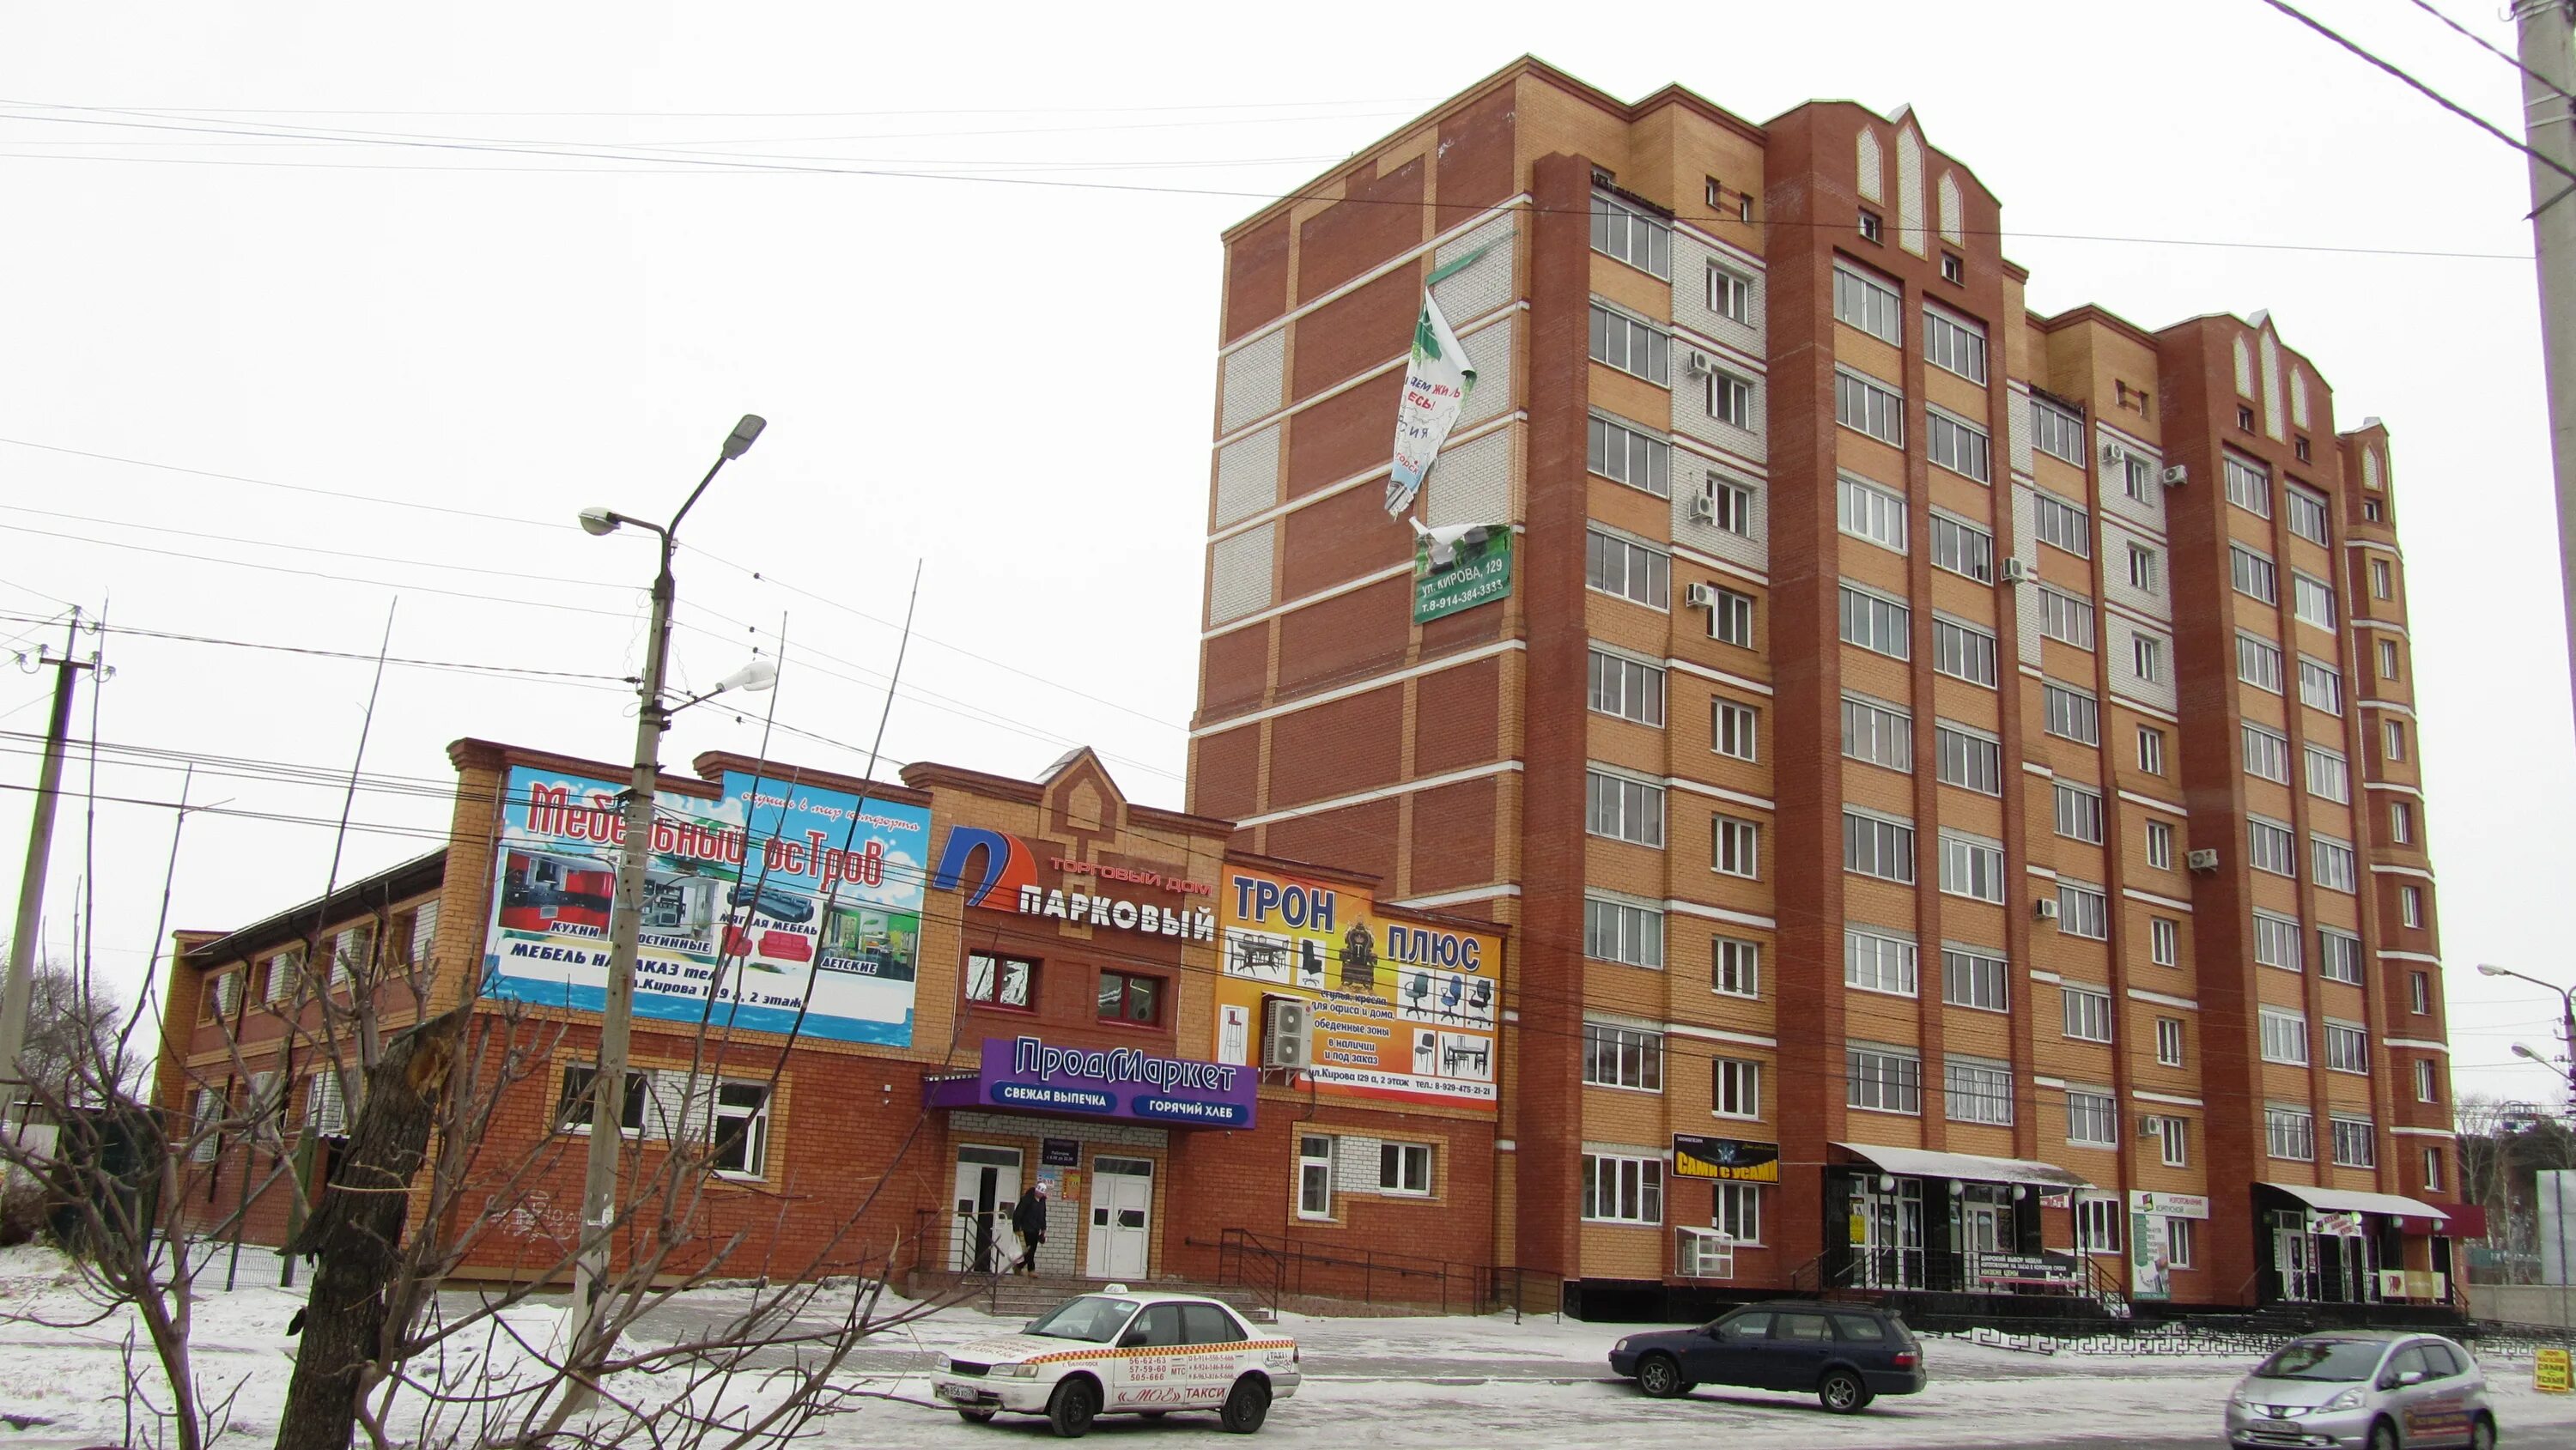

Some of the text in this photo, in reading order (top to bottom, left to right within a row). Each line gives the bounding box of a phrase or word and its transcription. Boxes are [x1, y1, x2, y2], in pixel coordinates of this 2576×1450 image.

[1422, 558, 1503, 598] ул. КИРОВА, 129
[1050, 857, 1213, 896] ТОРГОВЫЙ ДОМ
[1018, 883, 1215, 943] ПАРКОВЫЙ
[1232, 874, 1336, 933] ТРОН
[550, 921, 600, 937] КУХНИ
[720, 913, 818, 936] МЯГАЯ МЕБЕЛЬ
[638, 932, 711, 953] ОСТИННЫЕ
[1388, 924, 1480, 972] ПЛЮС
[510, 943, 587, 966] МЕБЕЛЬ
[635, 958, 680, 977] АКАЗ
[820, 956, 878, 974] ДЕТСКИЕ
[702, 986, 730, 999] 19
[750, 992, 759, 1004] 2
[762, 995, 803, 1009] этаж
[1330, 1003, 1361, 1016] офиса
[1362, 1007, 1369, 1016] и
[1314, 1018, 1391, 1036] обеденные зоны
[1328, 1038, 1376, 1052] в наличии
[1324, 1052, 1379, 1065] и под заказ
[1357, 1073, 1370, 1083] 129
[1380, 1076, 1387, 1084] 2
[1388, 1077, 1410, 1087] этаж
[1004, 1086, 1107, 1107] СВЕЖАЯ ВЫПЕЧКА
[1149, 1098, 1234, 1119] ГОРЯЧИЙ ХЛЕБ
[1676, 1151, 1778, 1182] САМИ С УСАМИ
[1185, 1387, 1227, 1399] ТАКСИ
